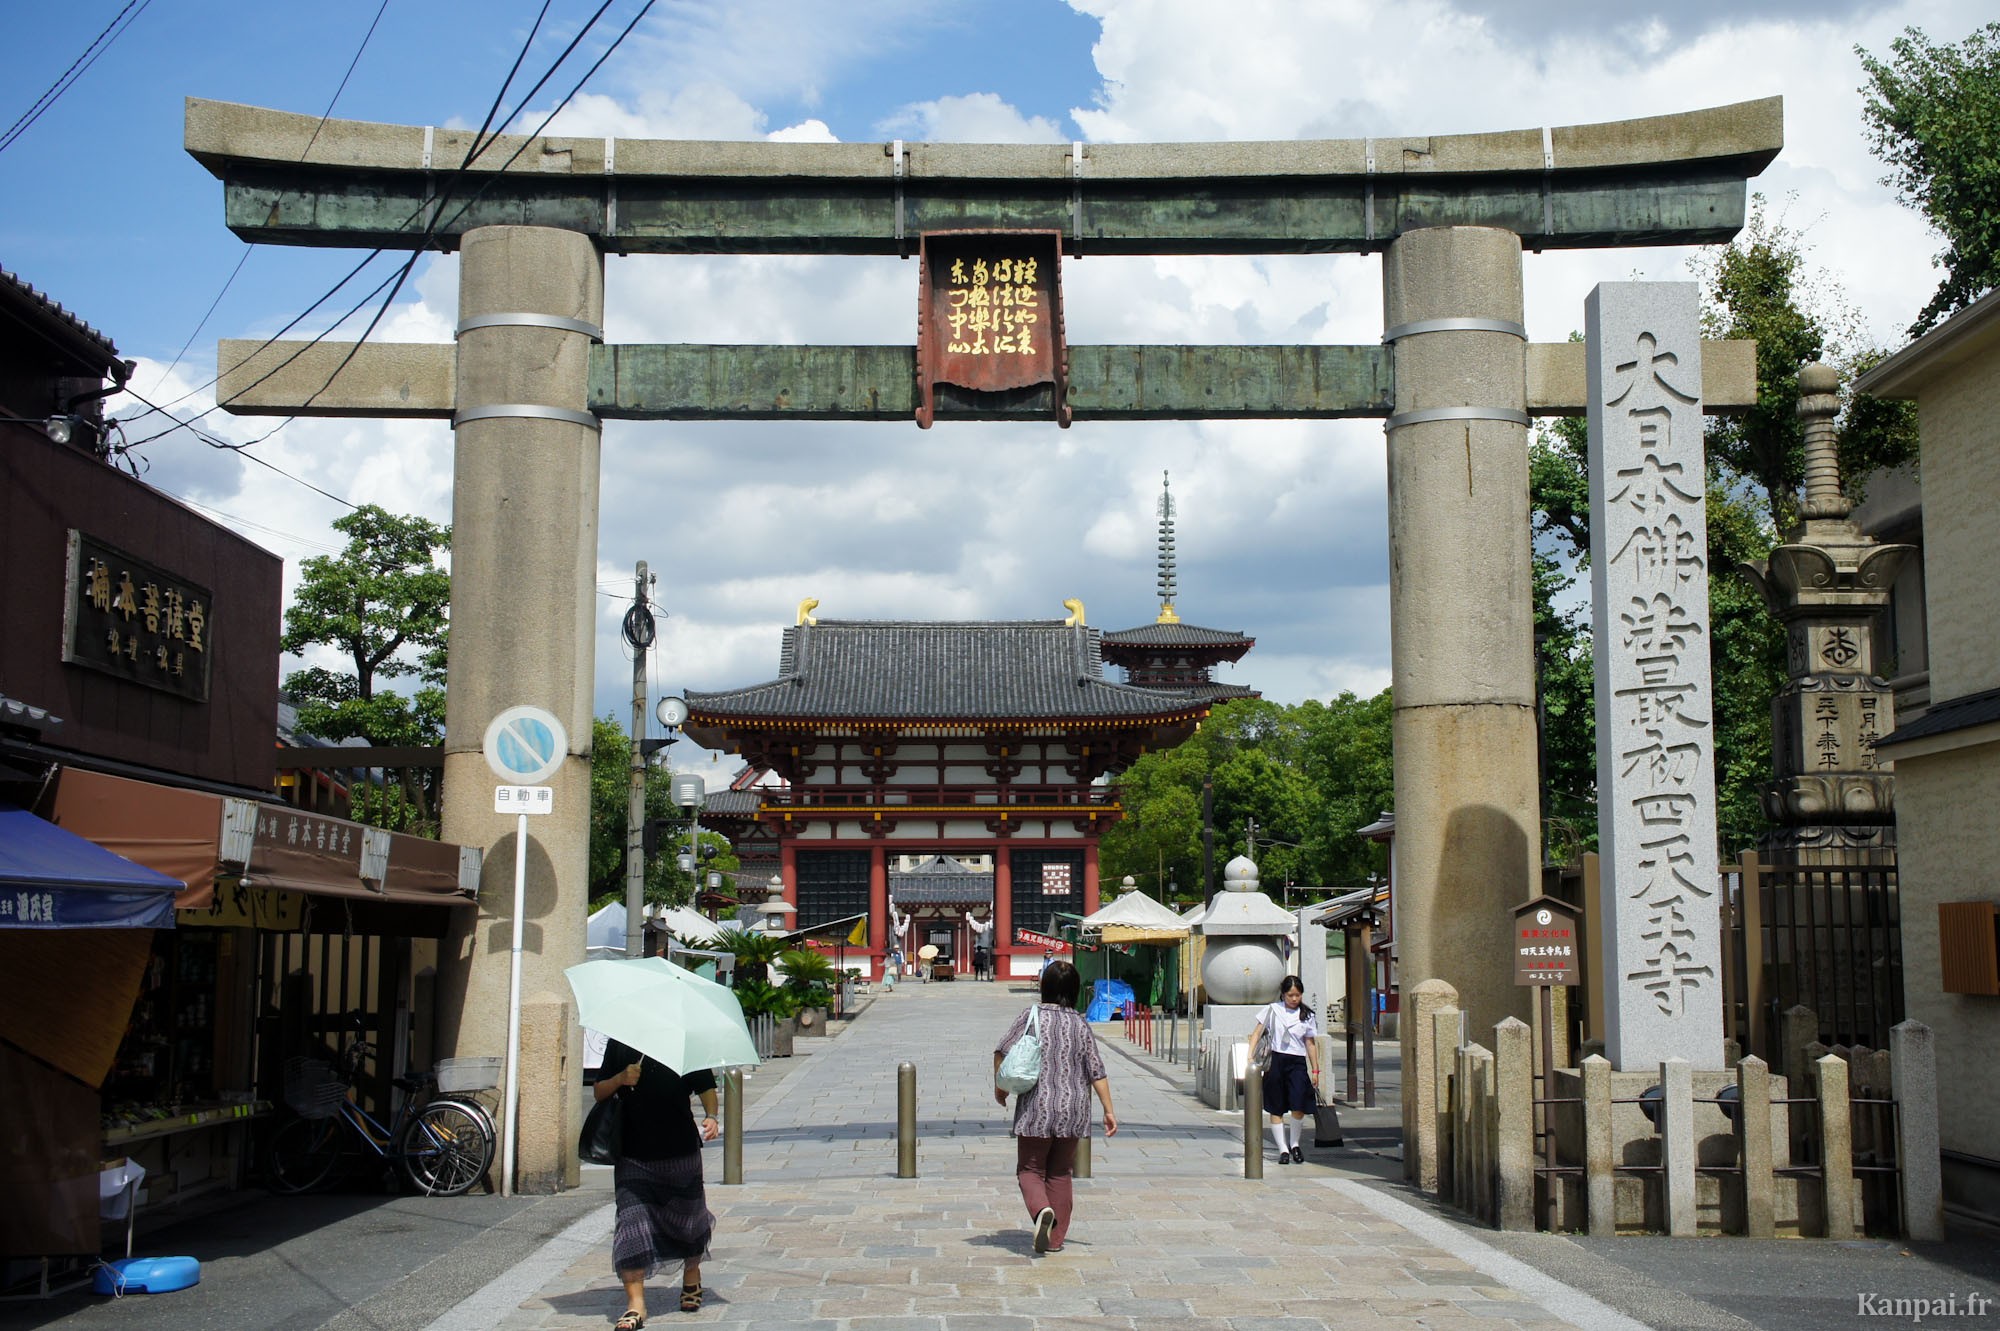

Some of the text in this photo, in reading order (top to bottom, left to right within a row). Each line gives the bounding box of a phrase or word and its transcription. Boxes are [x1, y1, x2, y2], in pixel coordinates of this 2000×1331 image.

[1816, 697, 1840, 771] 天下泰平
[498, 788, 549, 802] 自動車
[16, 892, 53, 921] 源氏堂
[1519, 946, 1572, 956] 四天王寺鳥居
